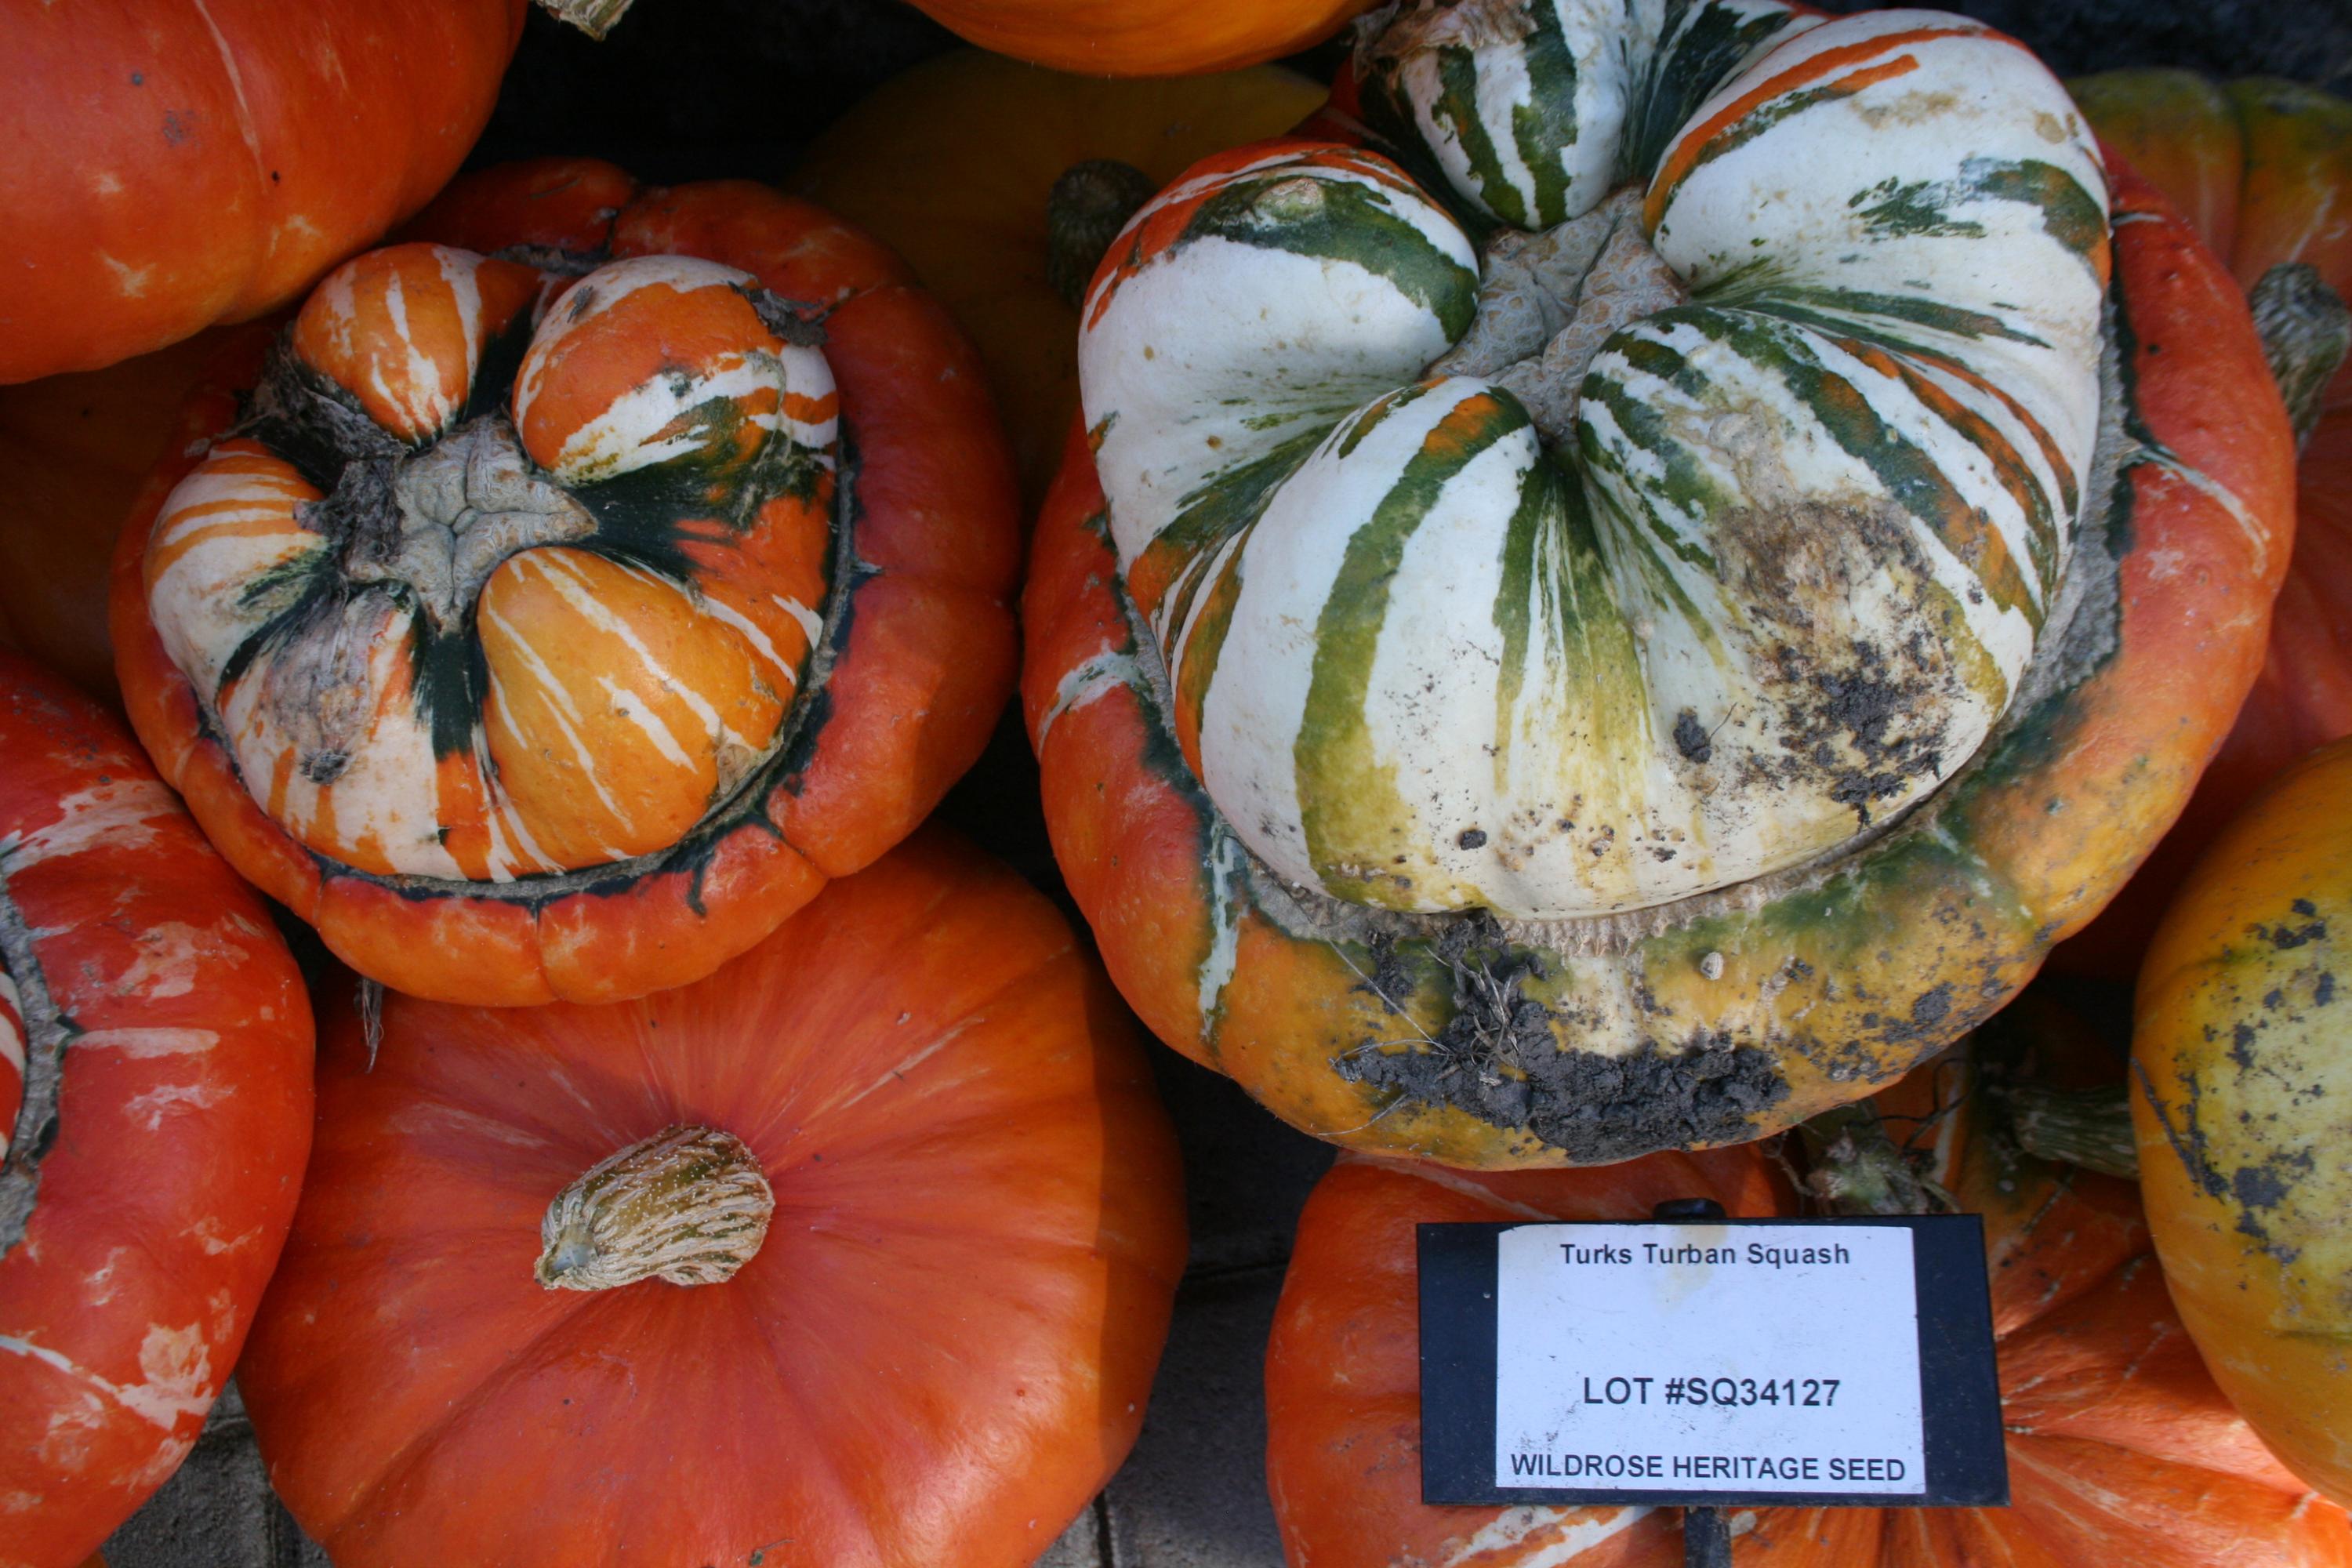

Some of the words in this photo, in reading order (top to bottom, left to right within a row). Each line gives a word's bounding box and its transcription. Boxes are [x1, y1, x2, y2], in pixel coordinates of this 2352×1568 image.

[1560, 1243, 1632, 1265] Turks
[1643, 1243, 1736, 1265] Turban
[1748, 1243, 1850, 1269] Squash
[1584, 1377, 1653, 1405] LOT
[1665, 1377, 1841, 1407] #SQ34127
[1511, 1454, 1664, 1477] WILDROSE
[1673, 1456, 1820, 1480] HERITAGE
[1829, 1458, 1905, 1481] SEED
